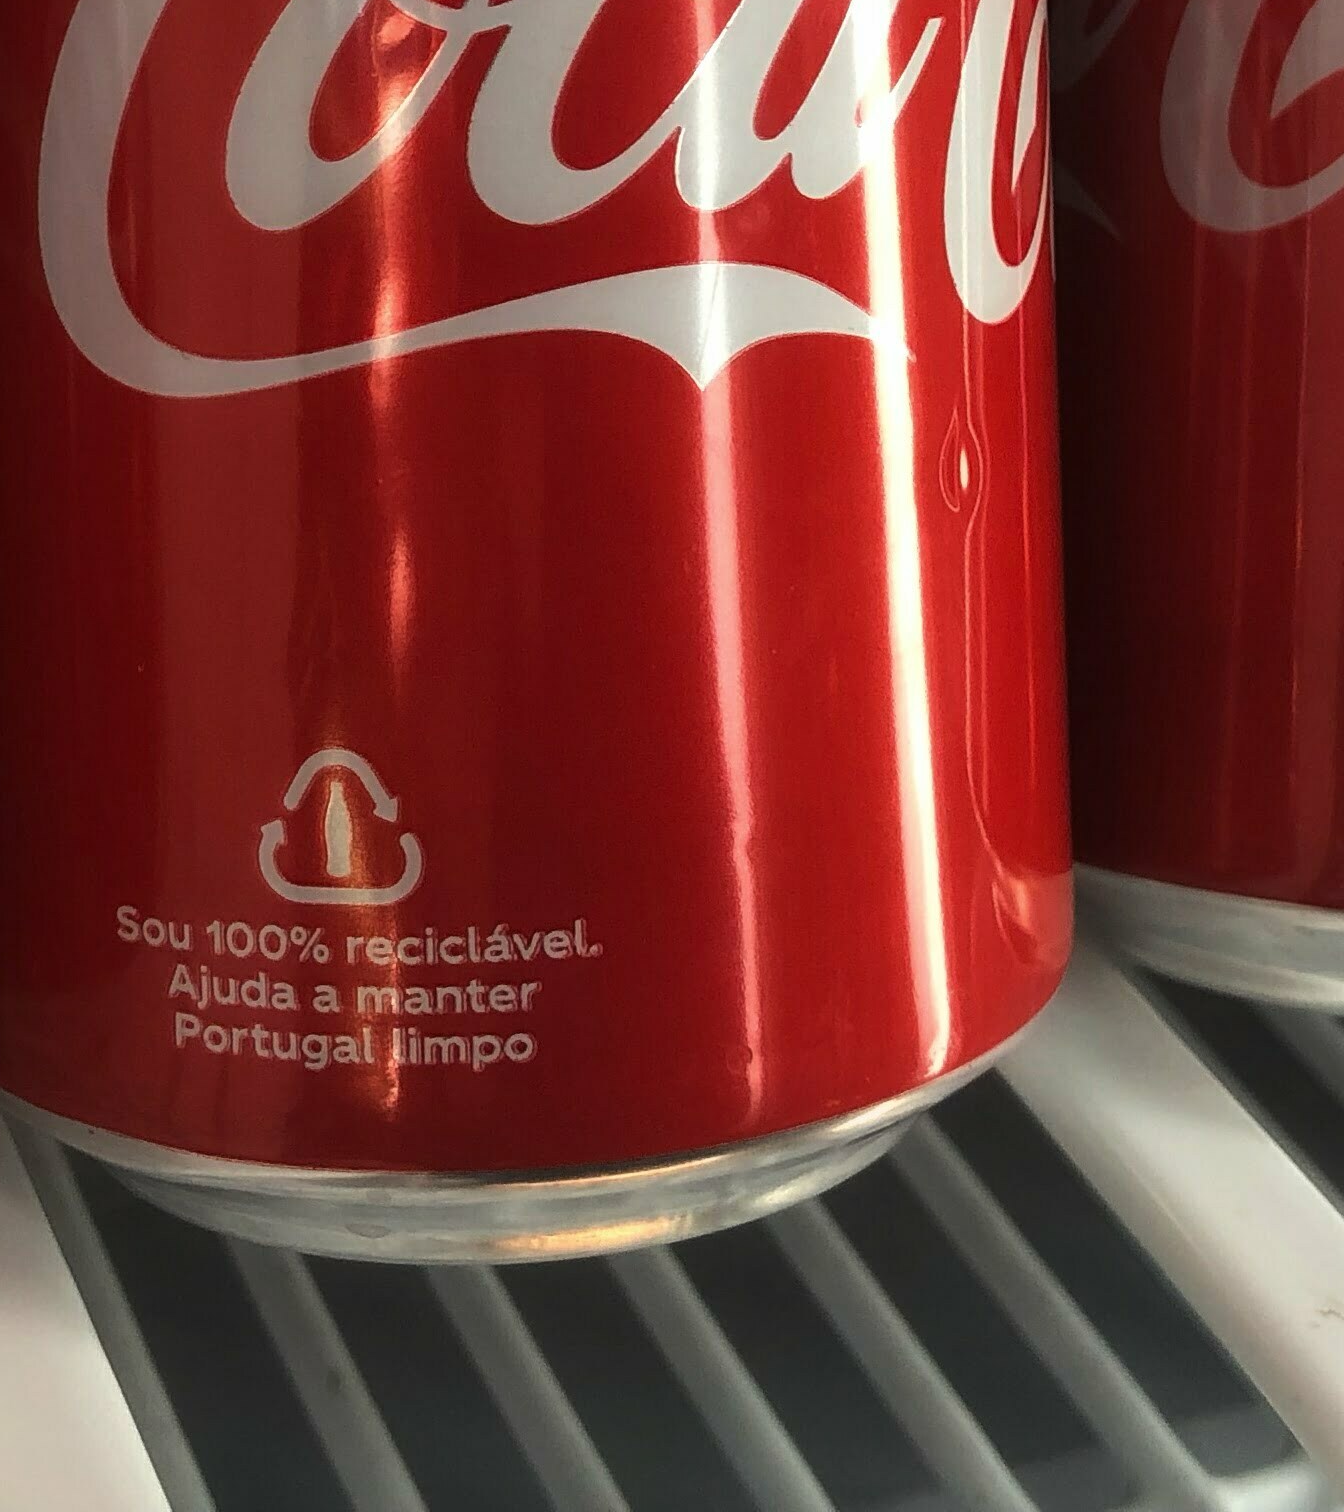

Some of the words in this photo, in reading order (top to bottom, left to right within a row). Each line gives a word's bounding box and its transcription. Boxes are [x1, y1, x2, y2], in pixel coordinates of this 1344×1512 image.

[117, 905, 194, 951] Sou
[206, 919, 331, 965] 100%
[346, 918, 604, 968] reciclável.
[168, 963, 299, 1011] Ajuda
[313, 984, 342, 1015] a
[356, 976, 542, 1017] manter
[174, 1010, 375, 1071] Portugal
[393, 1026, 540, 1073] limpo
